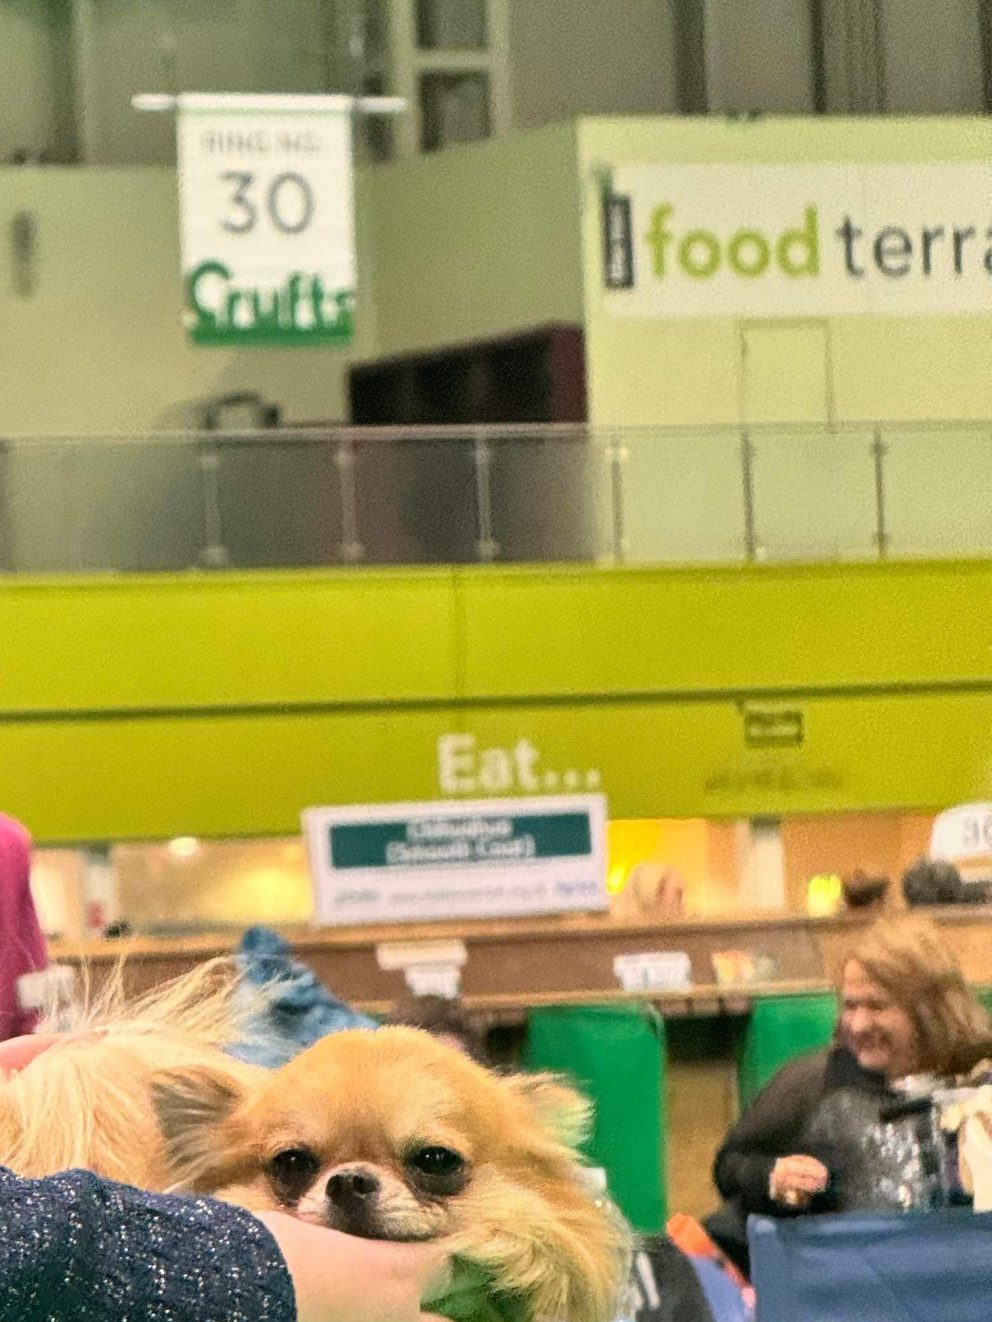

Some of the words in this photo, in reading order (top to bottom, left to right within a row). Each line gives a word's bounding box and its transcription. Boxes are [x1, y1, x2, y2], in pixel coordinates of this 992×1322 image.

[219, 171, 315, 235] 30
[648, 202, 820, 280] food
[836, 215, 992, 277] terr
[188, 257, 355, 330] Crufts
